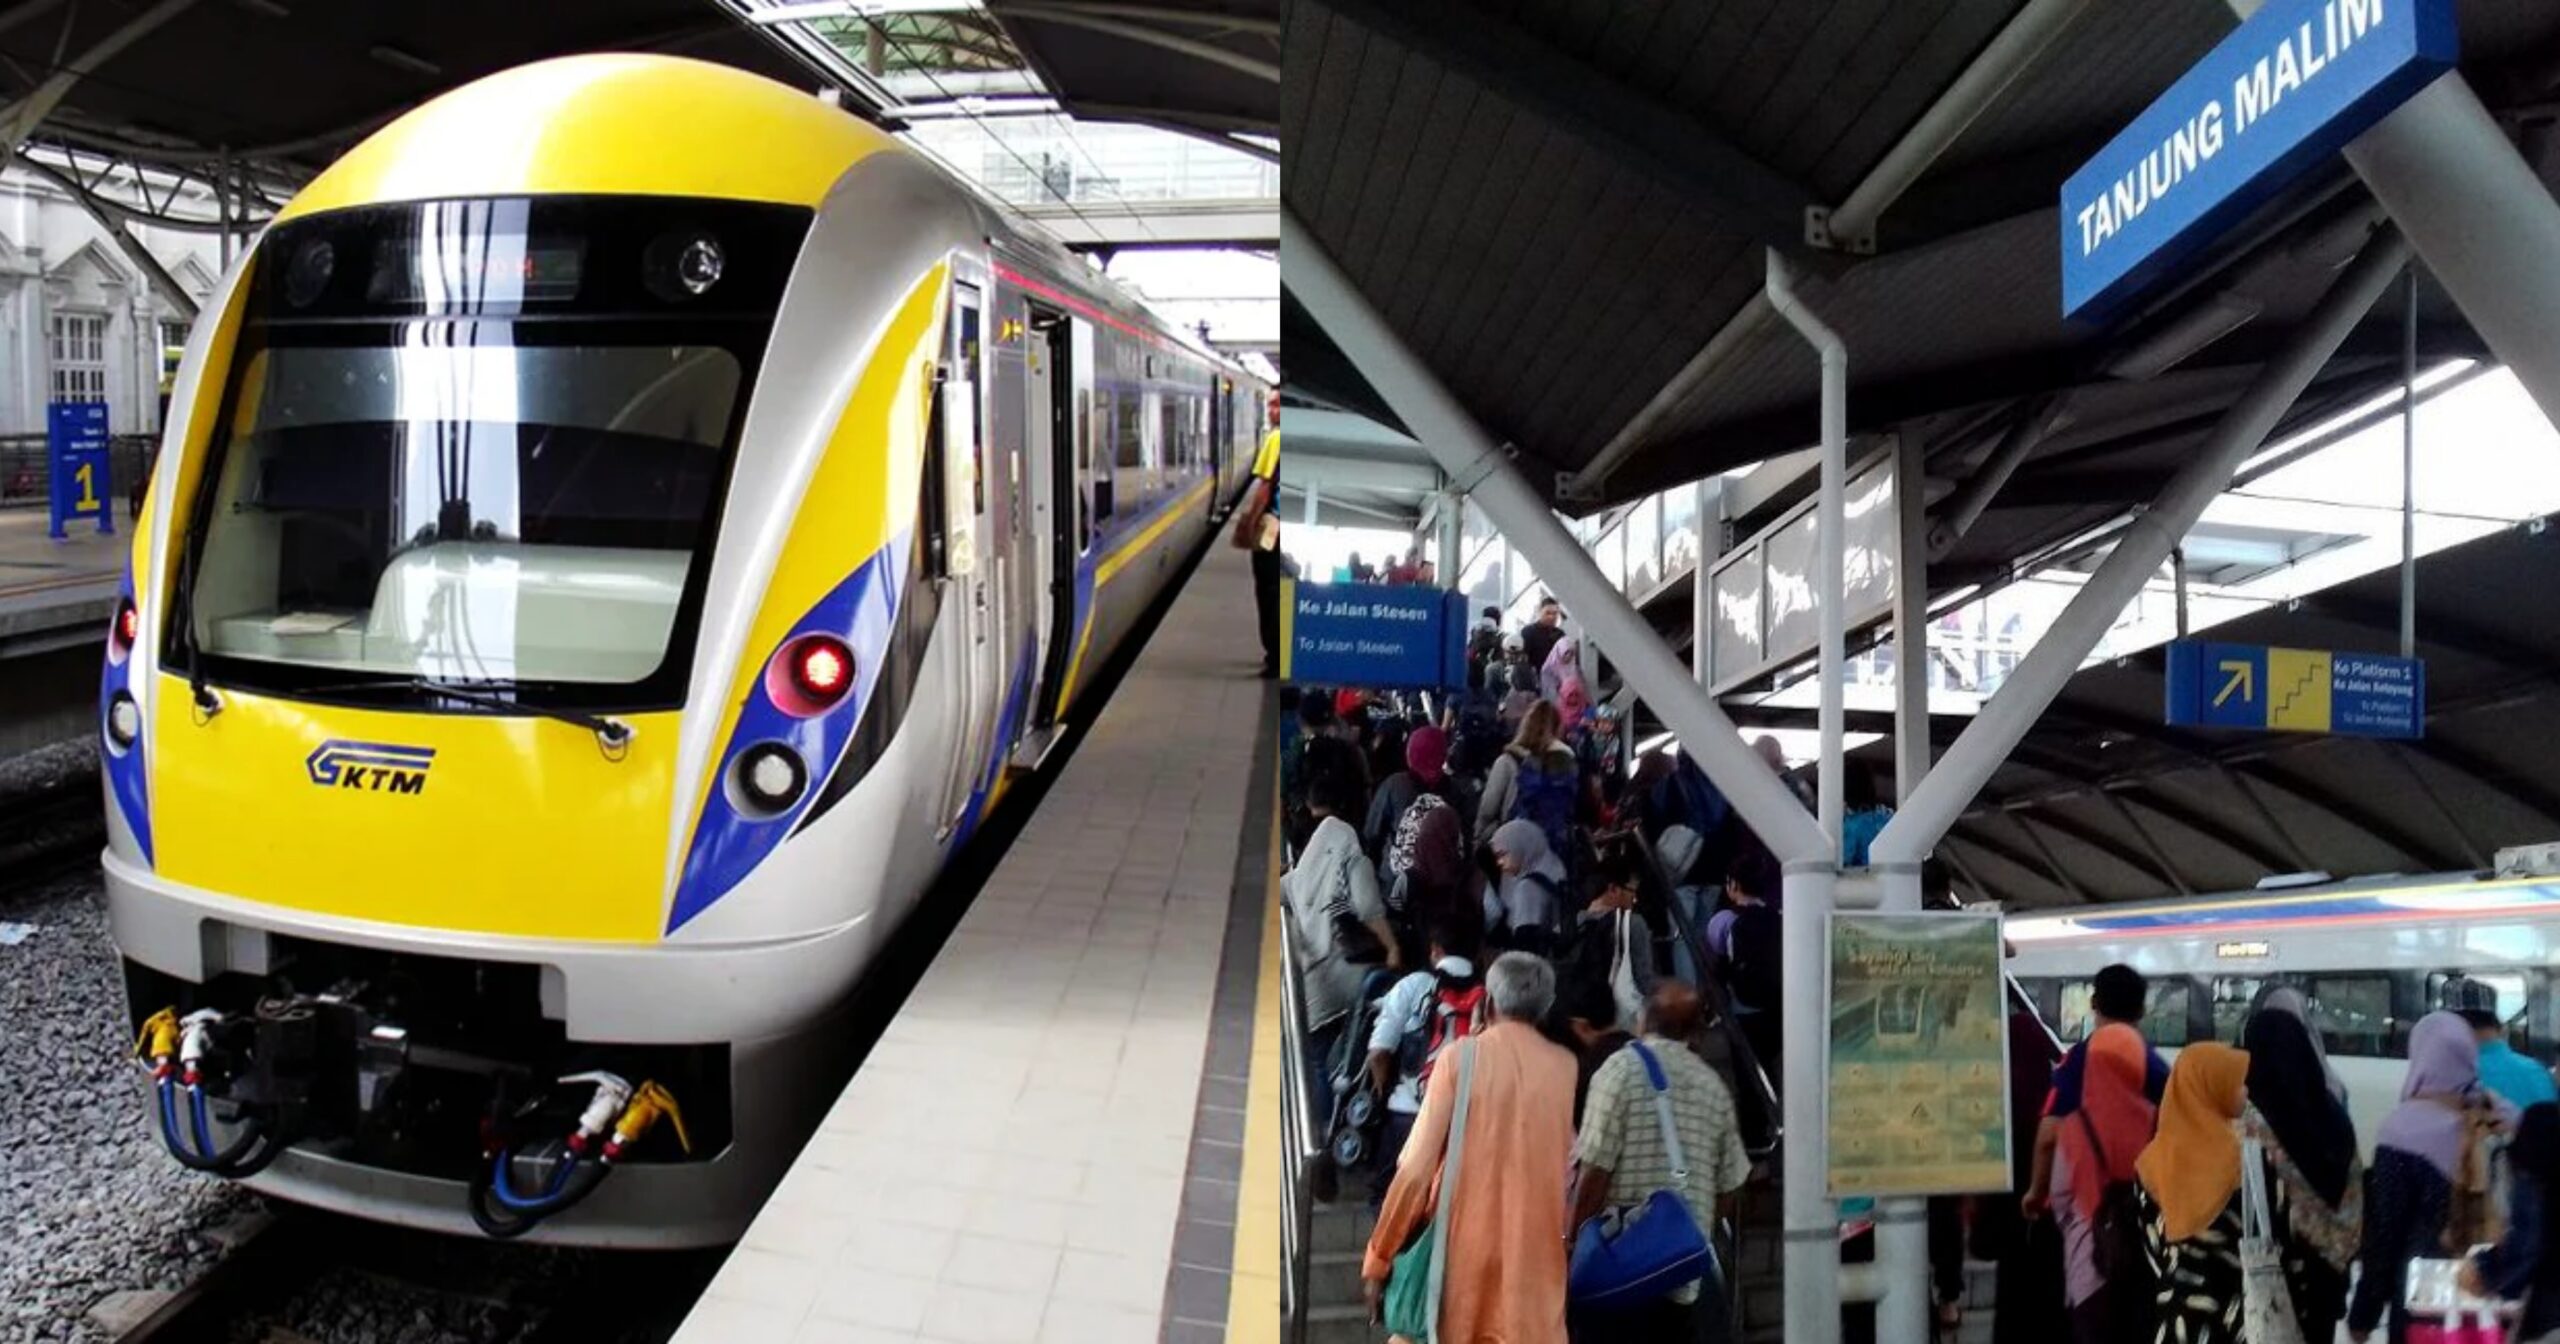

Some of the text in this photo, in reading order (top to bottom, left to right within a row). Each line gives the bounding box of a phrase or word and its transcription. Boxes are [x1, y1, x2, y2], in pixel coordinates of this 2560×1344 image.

[2077, 0, 2383, 257] TANJUNG MALIM
[75, 463, 100, 512] 1
[1298, 600, 1428, 621] Ke Jalan Stesen
[1299, 637, 1404, 656] To Jalan Stesen
[2333, 660, 2411, 680] Ke Platform 1
[342, 766, 426, 794] KTM
